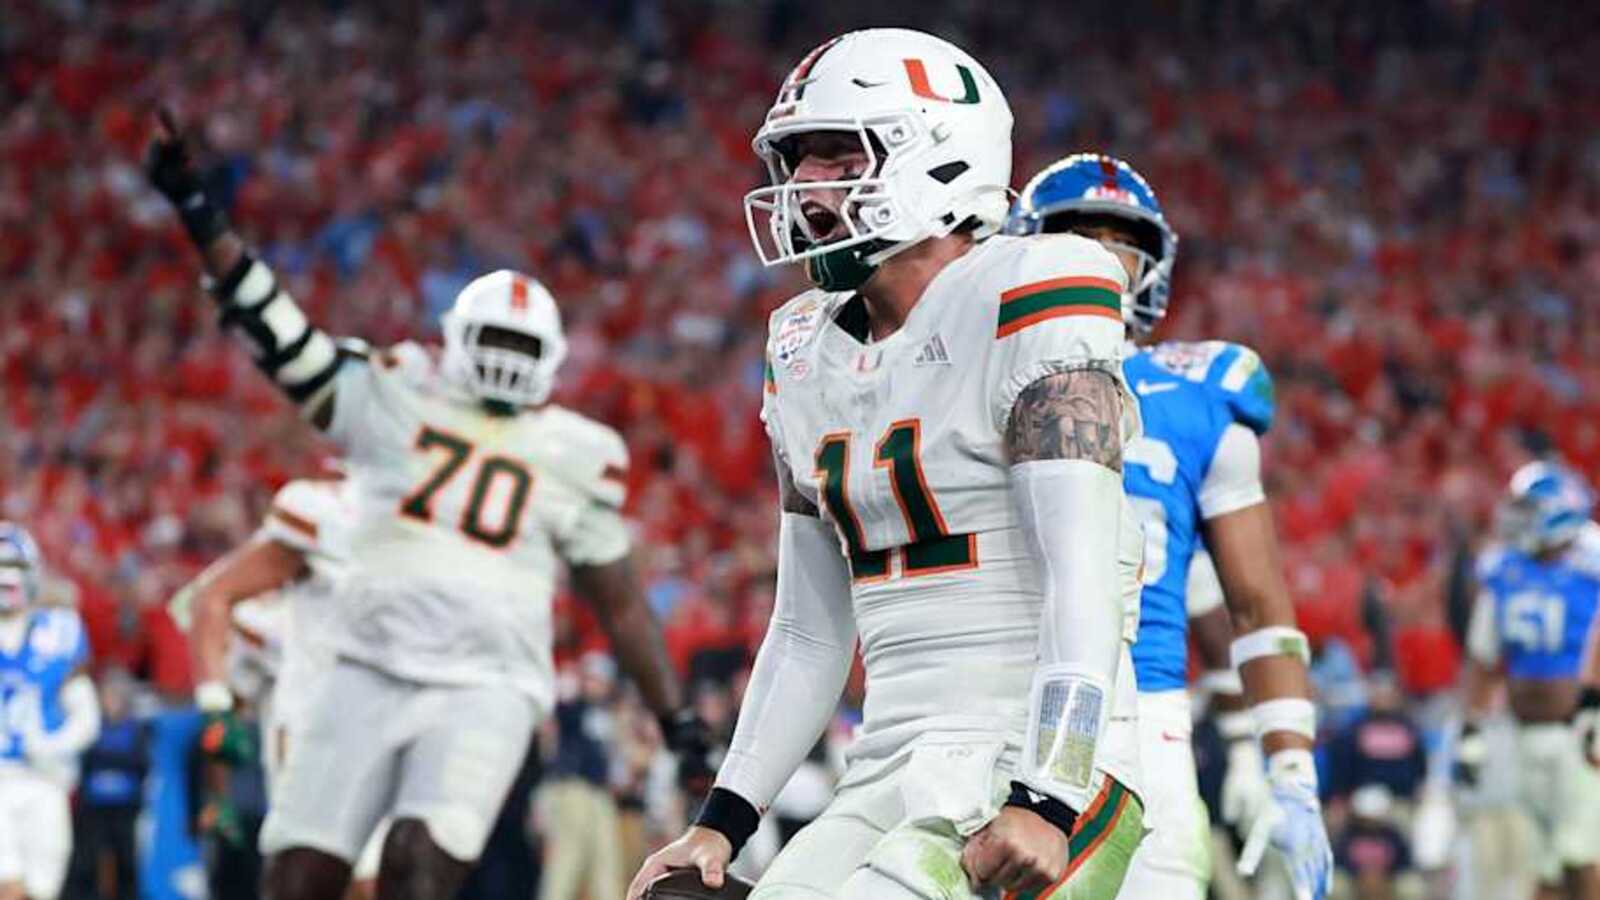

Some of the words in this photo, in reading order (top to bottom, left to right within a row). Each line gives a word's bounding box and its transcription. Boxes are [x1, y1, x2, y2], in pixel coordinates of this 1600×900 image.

[903, 58, 981, 104] U
[398, 422, 535, 549] 70
[811, 418, 979, 585] 11
